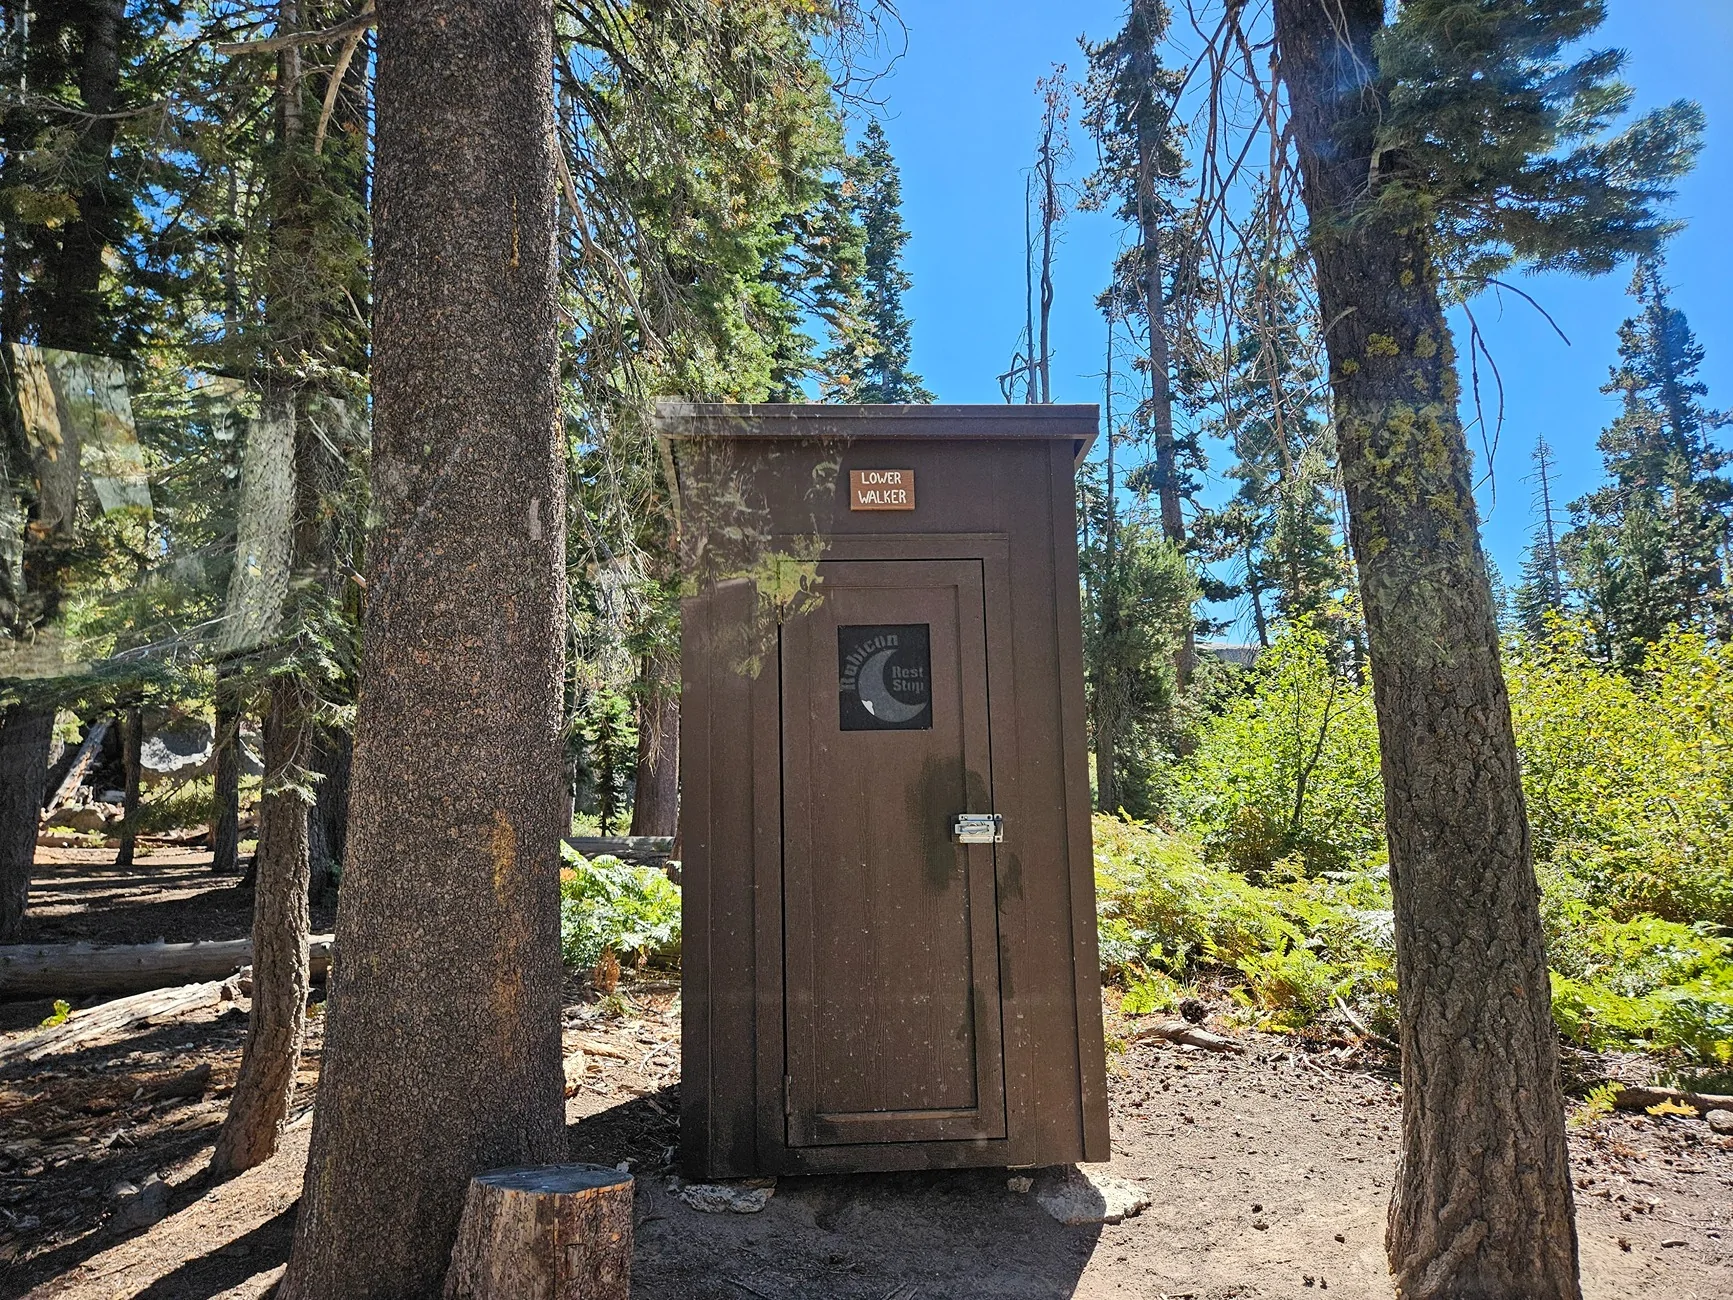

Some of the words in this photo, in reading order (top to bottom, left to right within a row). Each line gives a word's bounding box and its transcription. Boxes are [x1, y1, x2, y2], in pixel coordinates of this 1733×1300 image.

[862, 472, 901, 484] LOWER
[858, 490, 906, 503] WALKER
[840, 635, 898, 690] Rubicon
[892, 666, 923, 678] Rest
[892, 680, 923, 694] Stop
